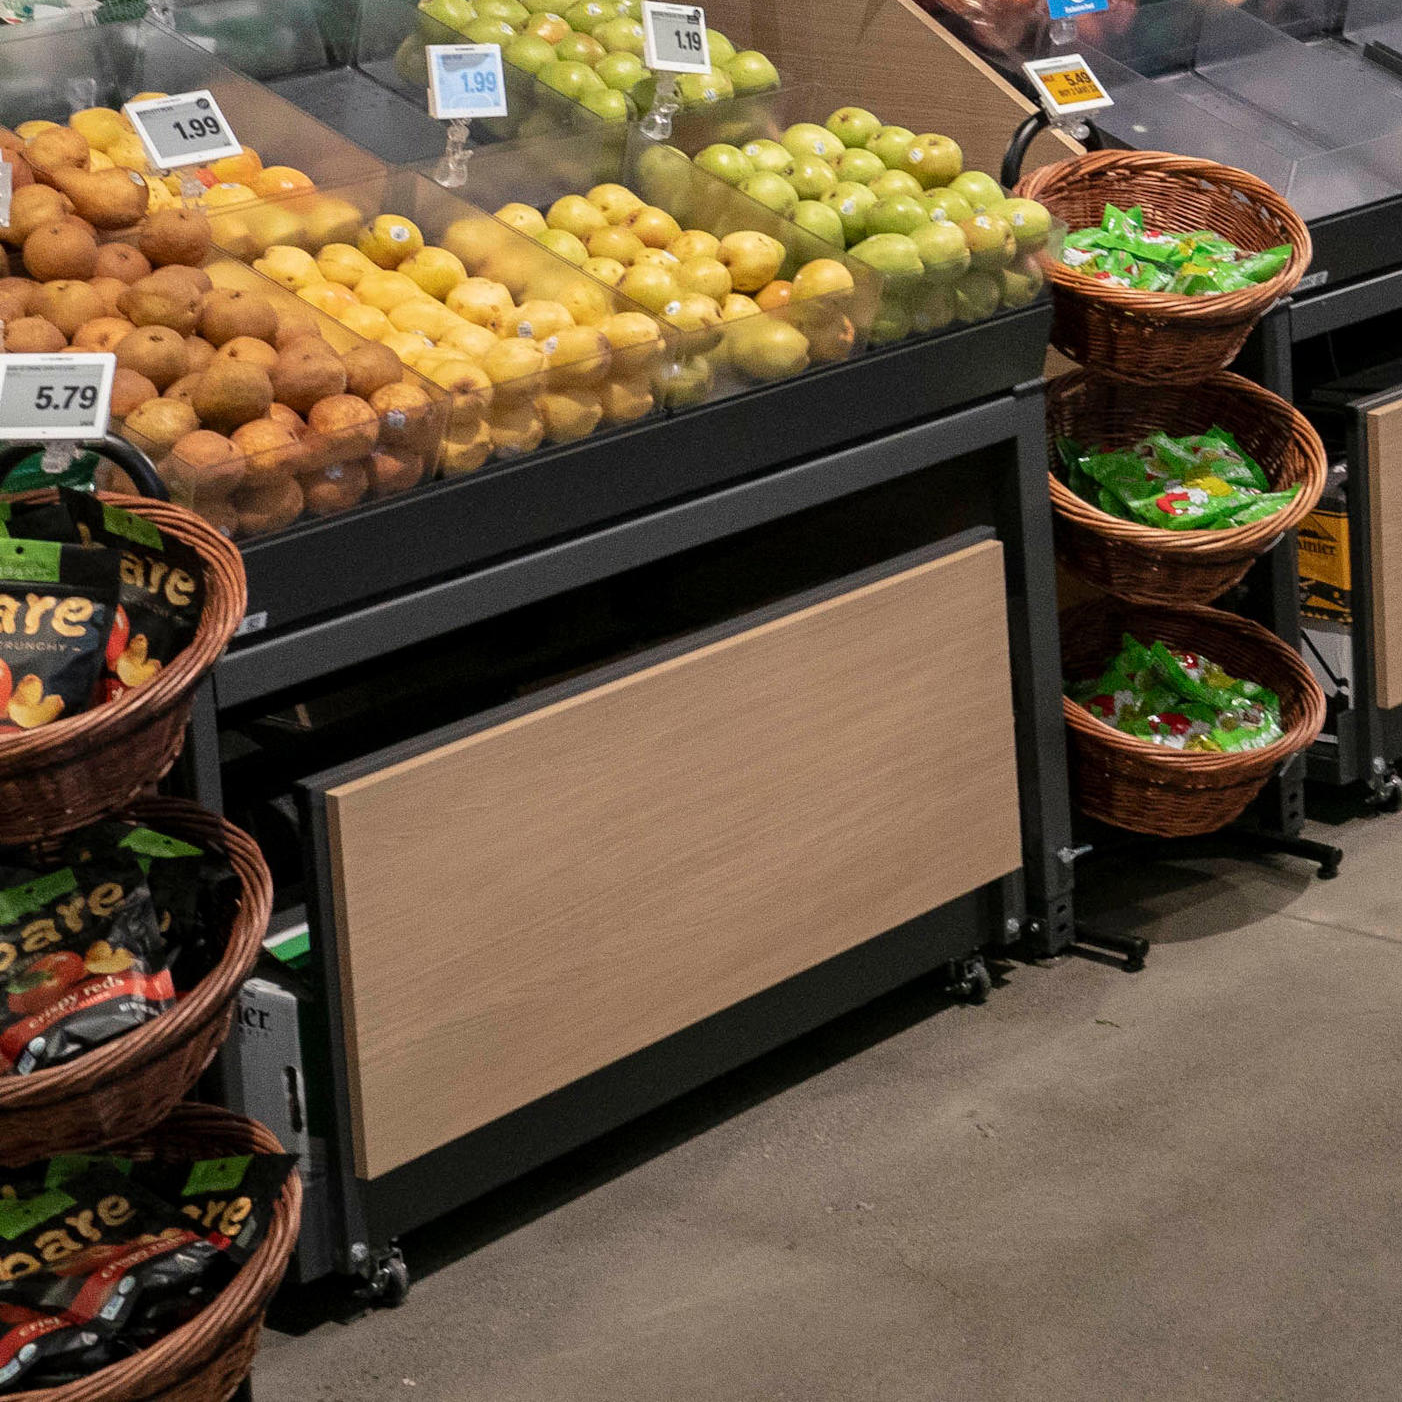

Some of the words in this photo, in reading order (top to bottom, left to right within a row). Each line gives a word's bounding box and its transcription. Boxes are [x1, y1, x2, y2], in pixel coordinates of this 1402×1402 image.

[674, 29, 702, 52] 1.19
[460, 71, 498, 94] 1.99
[1063, 71, 1092, 86] 5.49
[172, 116, 222, 141] 1.99
[35, 384, 99, 411] 5.79
[118, 549, 197, 607] are
[0, 592, 94, 637] are
